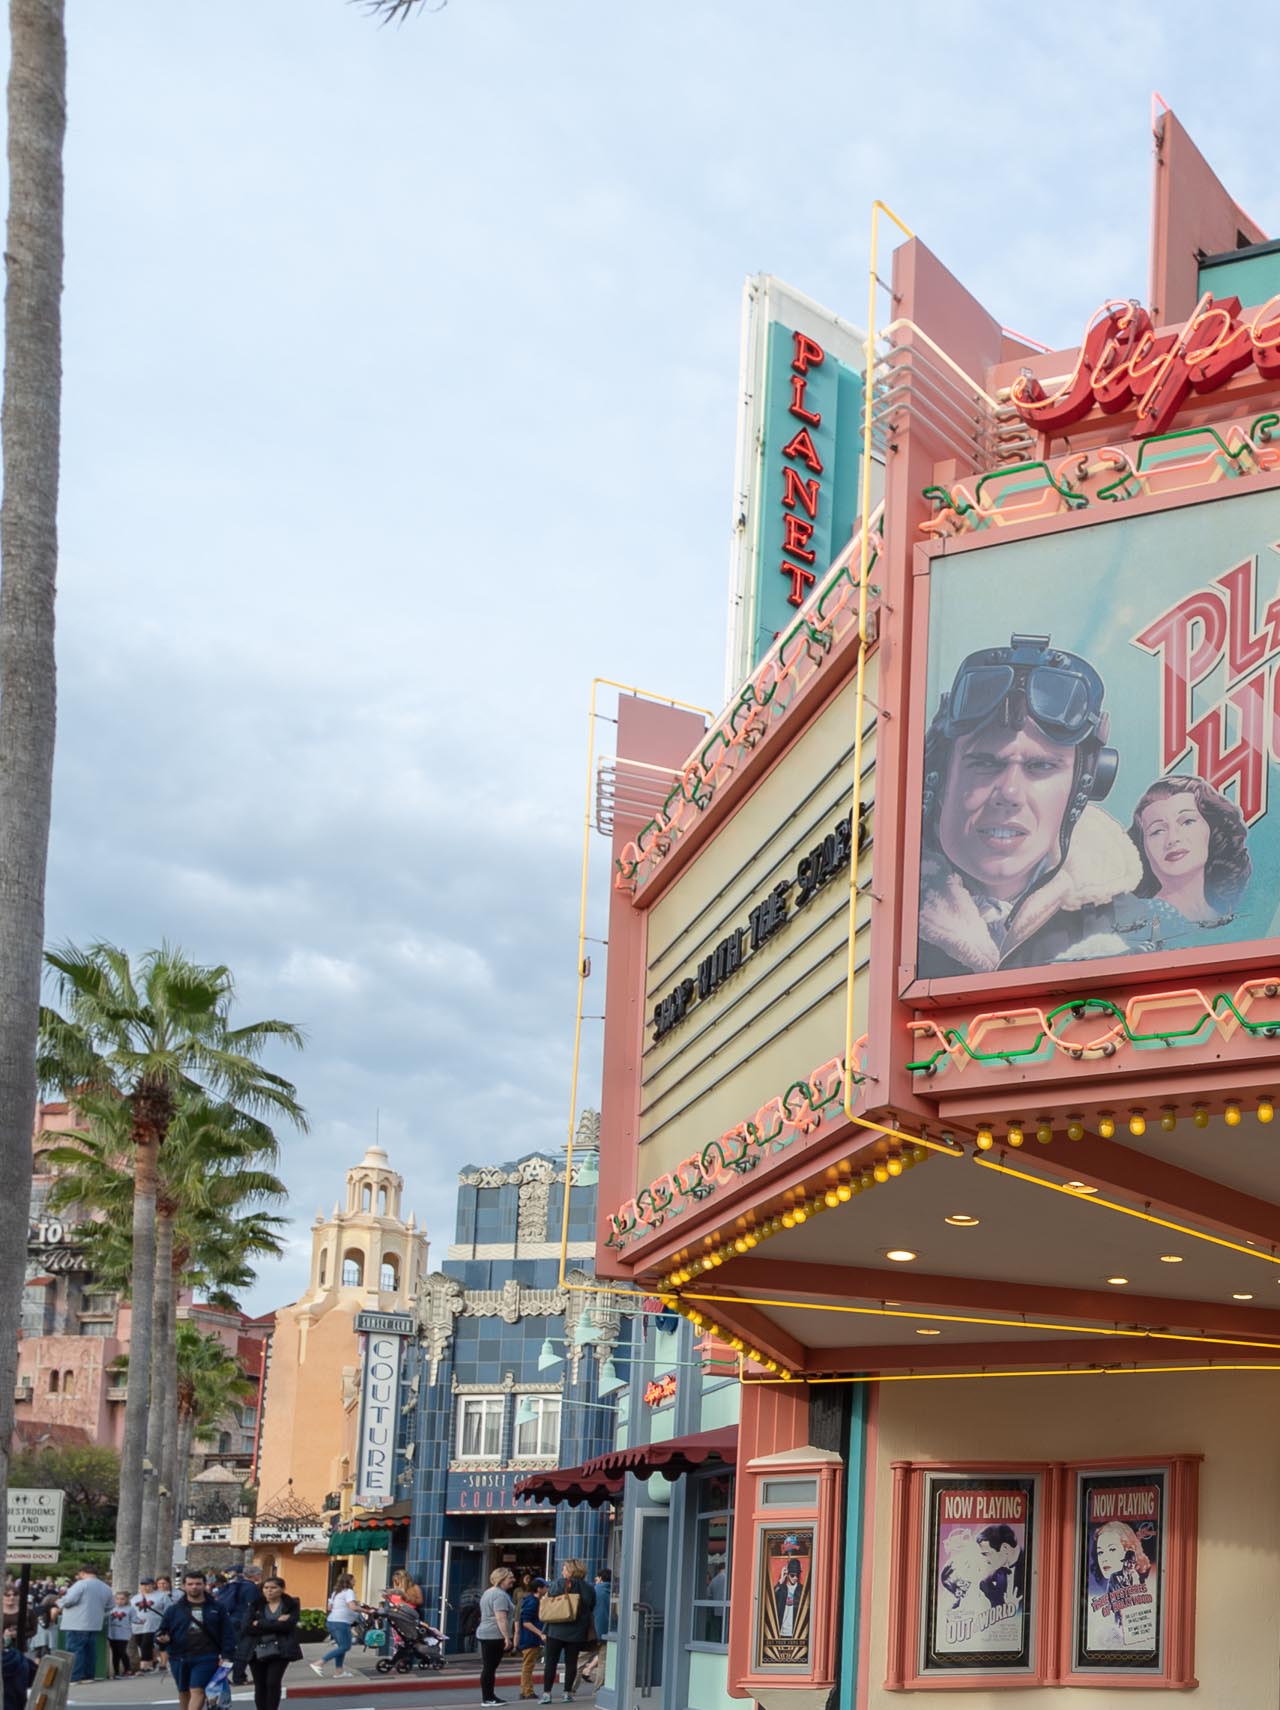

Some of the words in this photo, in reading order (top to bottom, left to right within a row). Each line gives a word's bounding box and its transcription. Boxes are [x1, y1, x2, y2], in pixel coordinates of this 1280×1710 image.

[781, 331, 825, 608] PLANET
[697, 926, 744, 1000] WITH
[748, 879, 790, 950] THE
[366, 1340, 394, 1489] COUTURE
[469, 1474, 506, 1488] SUNSET
[460, 1490, 543, 1507] COUTU
[945, 1496, 973, 1519] NOW
[976, 1496, 1022, 1518] PLAYING
[1093, 1495, 1115, 1518] NOW
[1117, 1492, 1155, 1517] PLAYING
[8, 1525, 55, 1533] ELEPHONES
[945, 1617, 974, 1644] OUT
[978, 1604, 1016, 1632] WORLD
